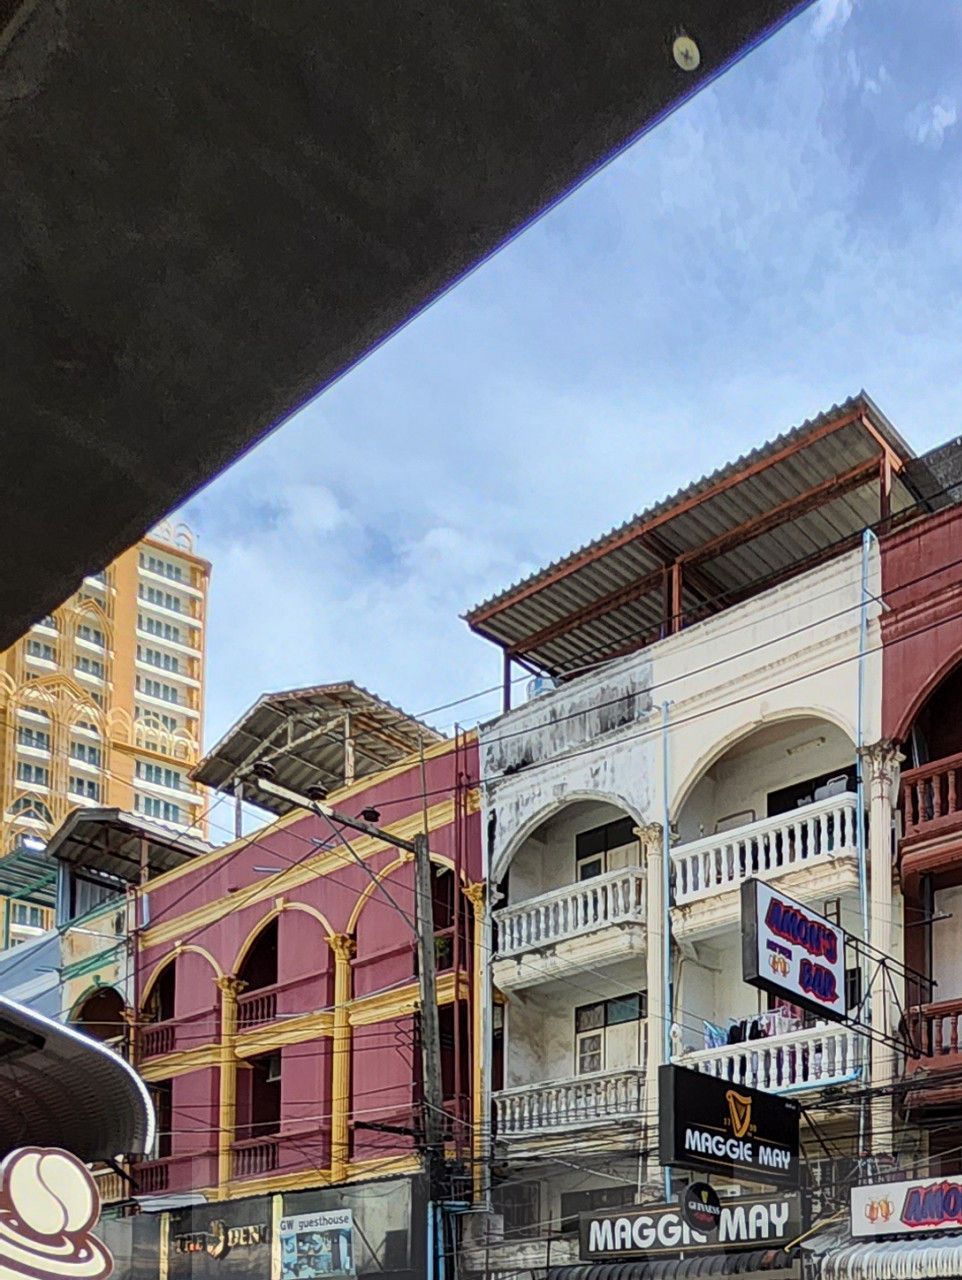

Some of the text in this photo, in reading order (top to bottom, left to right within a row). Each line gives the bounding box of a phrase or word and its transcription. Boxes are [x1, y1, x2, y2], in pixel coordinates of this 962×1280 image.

[798, 958, 839, 1004] BAR
[685, 1128, 791, 1170] MAGGIE MAY
[279, 1214, 350, 1232] GW guesthouse
[719, 1202, 789, 1242] MAY
